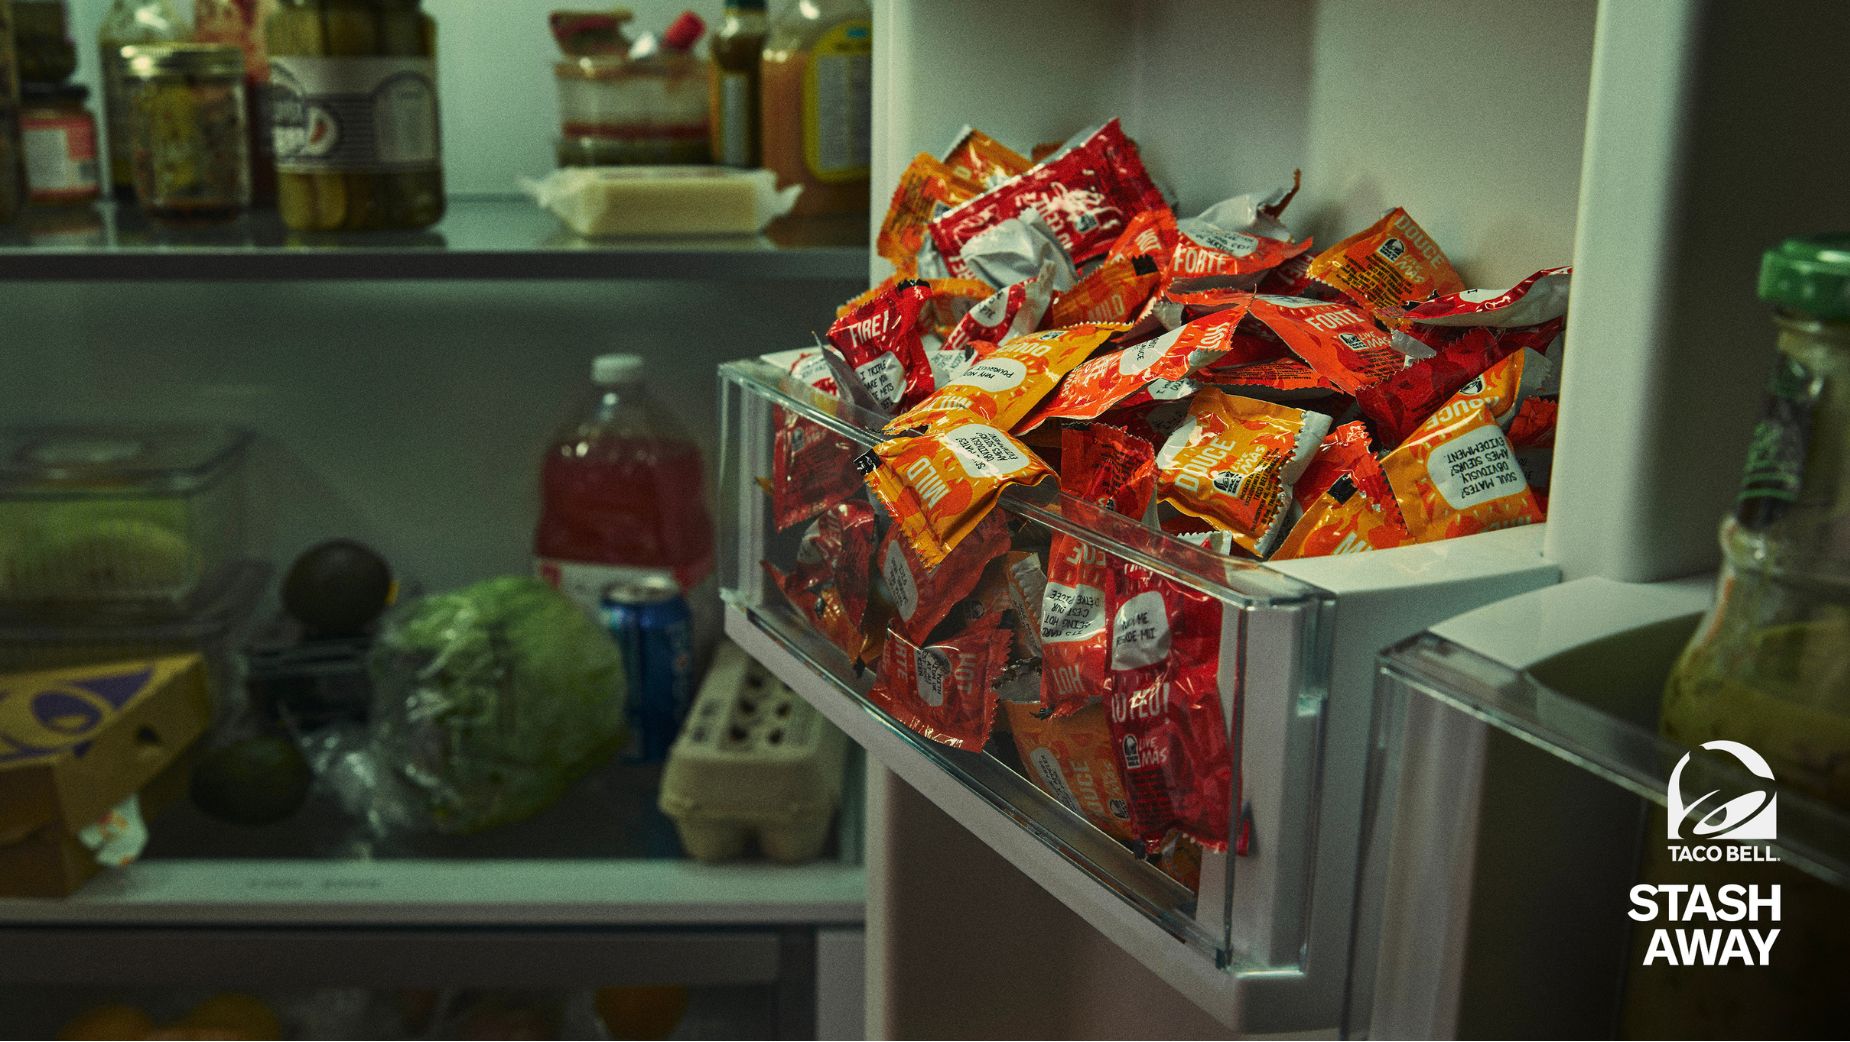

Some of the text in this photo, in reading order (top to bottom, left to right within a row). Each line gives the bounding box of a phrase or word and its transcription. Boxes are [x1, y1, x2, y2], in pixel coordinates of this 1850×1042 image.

[1173, 242, 1228, 273] FORTE
[1393, 214, 1442, 270] DOUCE
[1305, 308, 1366, 332] FORTE
[1174, 437, 1236, 493] DOUCE
[906, 456, 951, 510] MILD
[1461, 471, 1518, 499] SOUL MATES?
[1044, 614, 1060, 626] HOT
[1053, 663, 1086, 696] HOT
